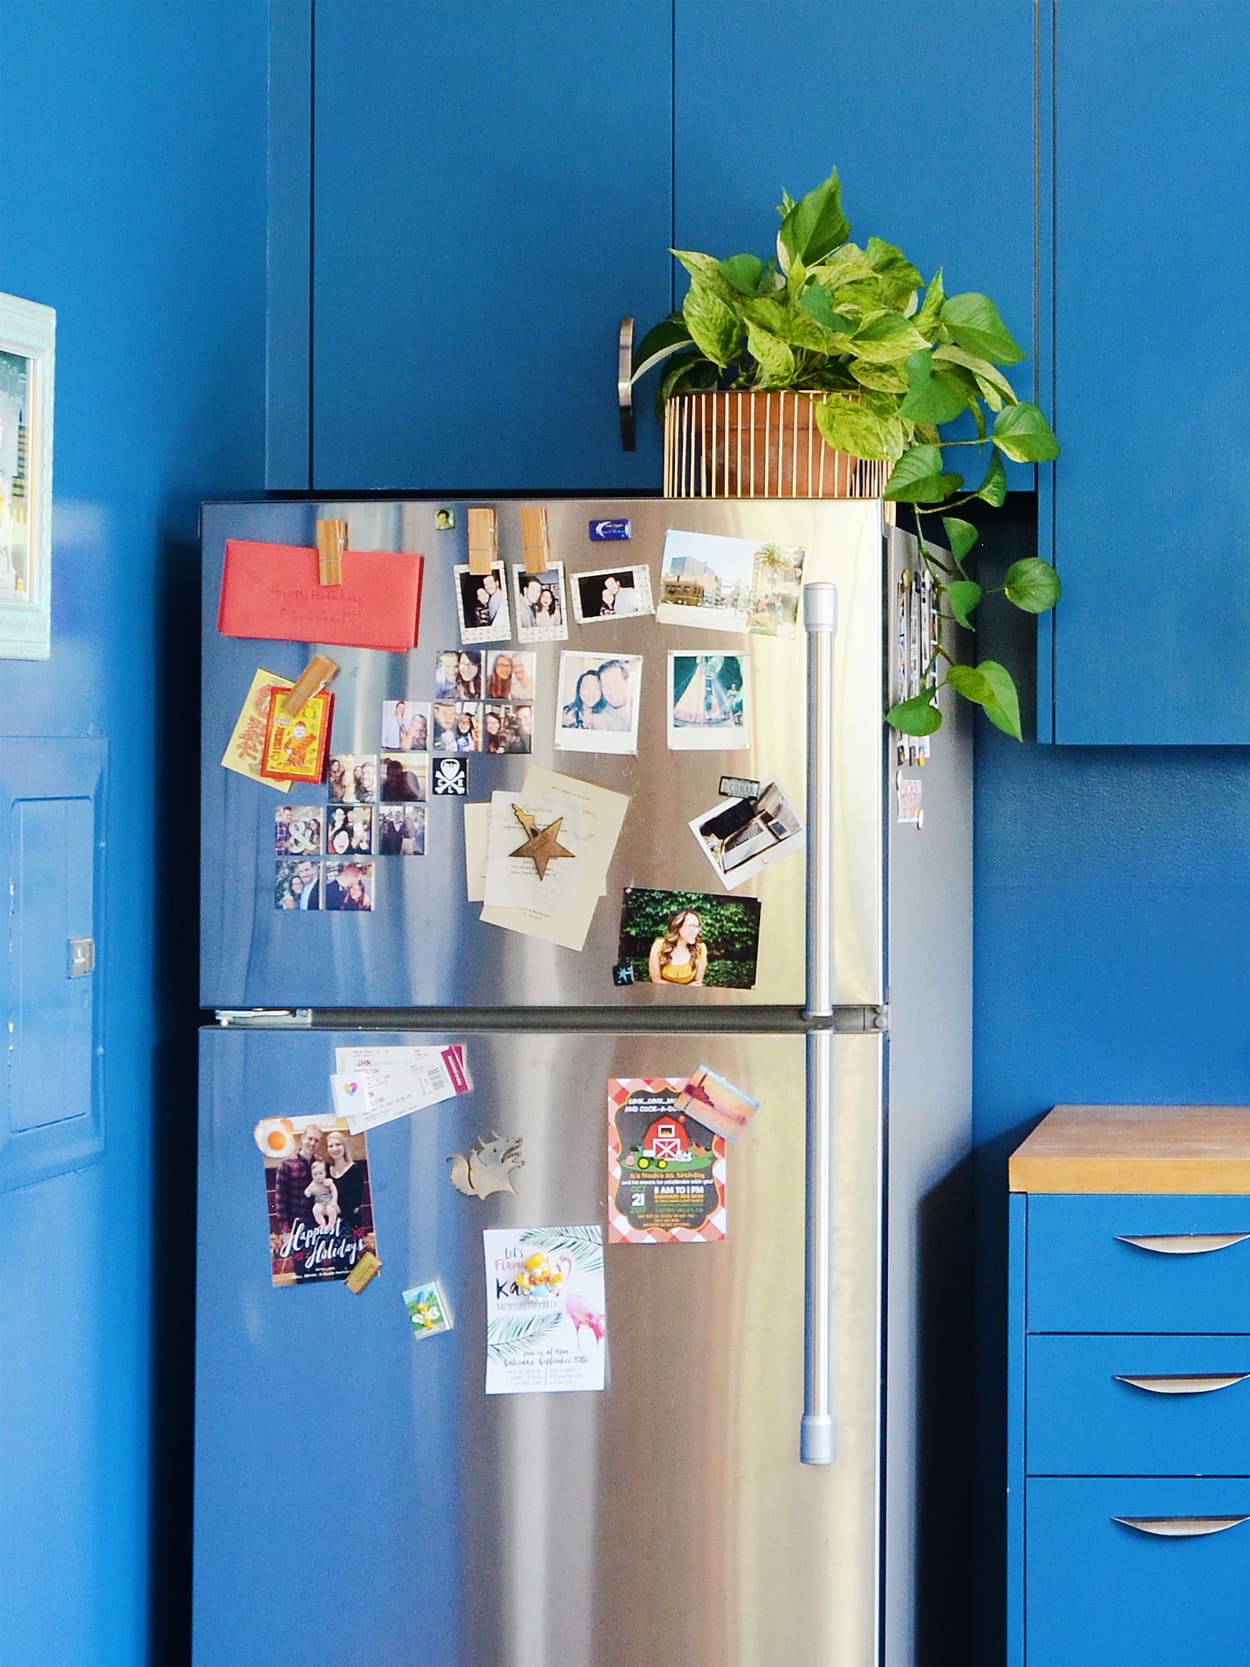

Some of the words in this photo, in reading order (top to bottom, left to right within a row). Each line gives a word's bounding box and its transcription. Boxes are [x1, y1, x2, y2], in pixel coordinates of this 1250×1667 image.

[631, 1193, 646, 1207] 21
[660, 1186, 675, 1194] AM
[675, 1186, 686, 1194] TO
[691, 1186, 705, 1194] PM
[279, 1217, 343, 1258] Happiest
[304, 1236, 364, 1269] Holidays
